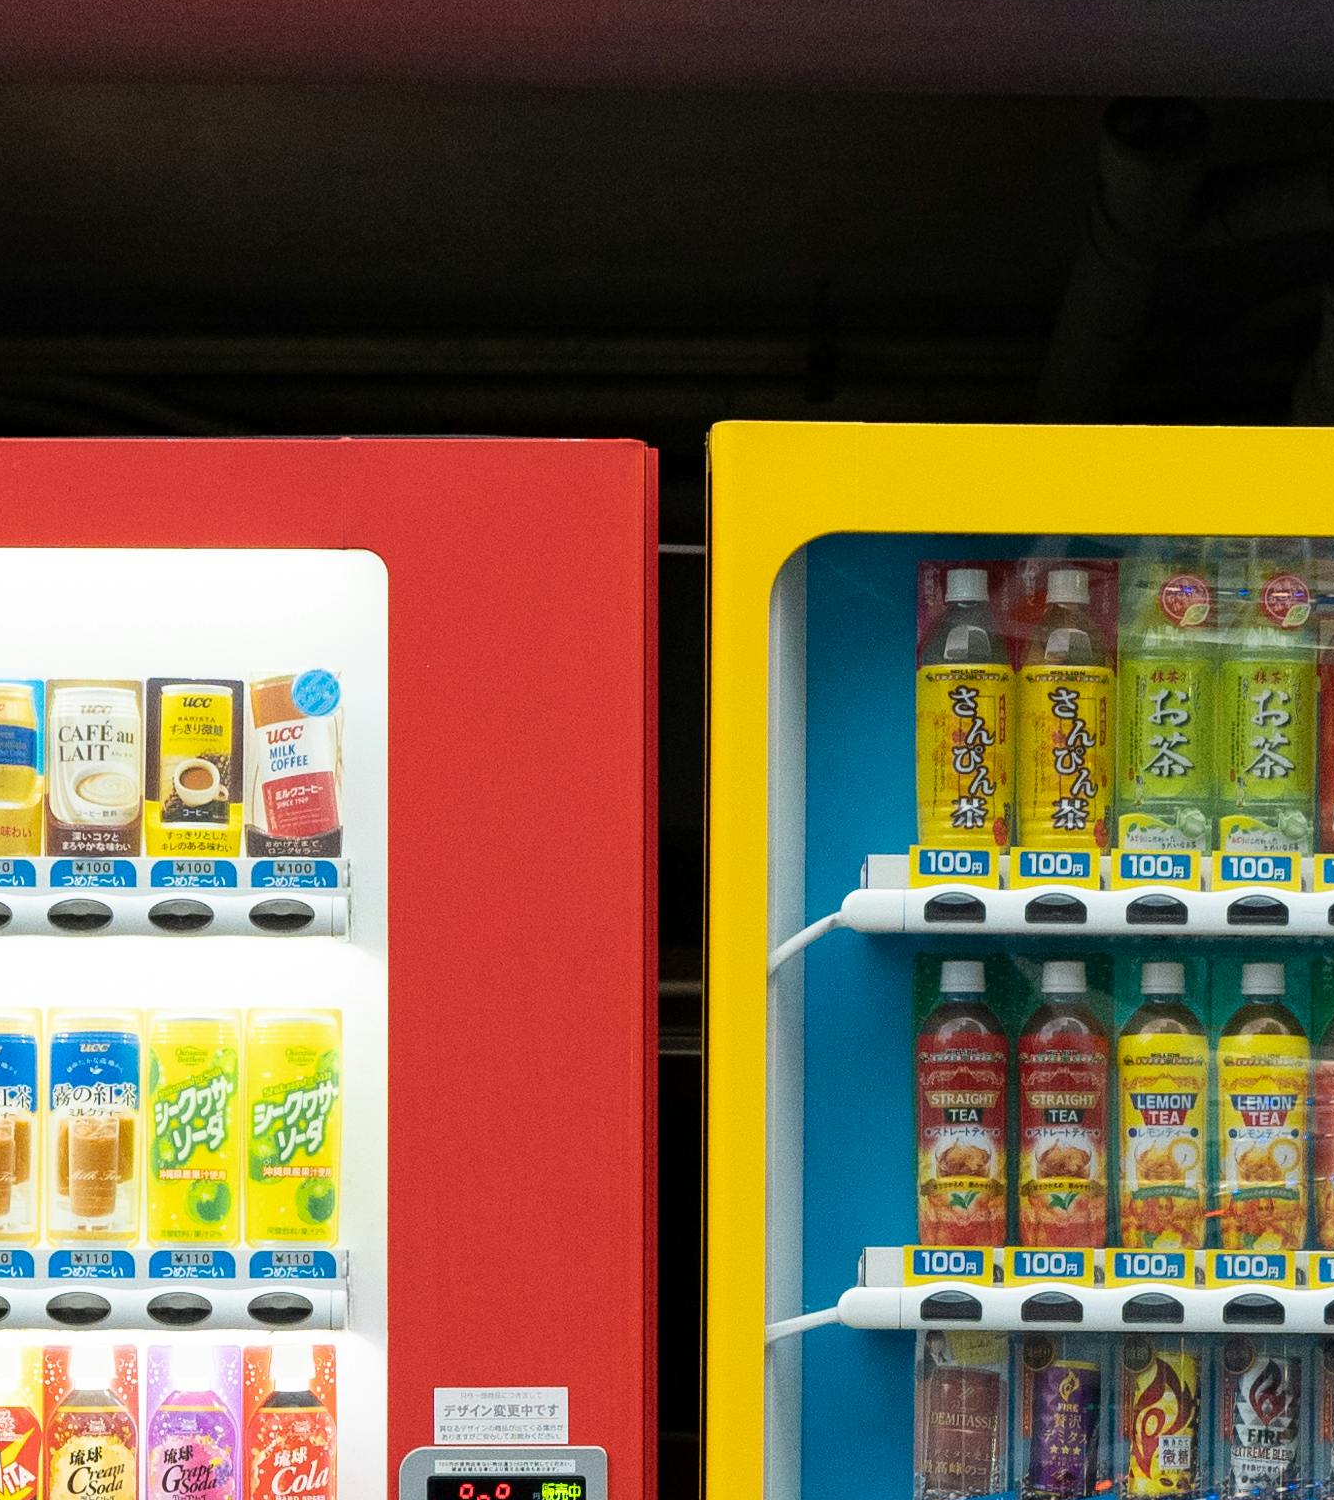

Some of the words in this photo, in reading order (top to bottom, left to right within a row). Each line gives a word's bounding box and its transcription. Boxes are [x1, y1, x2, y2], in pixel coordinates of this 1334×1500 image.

[59, 722, 113, 744] CAFÉ
[116, 731, 134, 744] au
[1144, 689, 1195, 780] お茶
[1245, 689, 1295, 780] お茶
[59, 745, 109, 762] LAIT
[269, 744, 296, 759] MILK
[949, 686, 996, 829] さんぴん茶
[1049, 687, 1097, 831] さんぴん茶
[271, 754, 309, 772] COFFEE
[275, 783, 324, 800] ミルクコーヒー
[61, 841, 132, 852] まろやかな味わい
[71, 832, 120, 843] 深いコクと
[276, 862, 312, 873] ¥100
[928, 851, 983, 874] 100円
[1129, 855, 1184, 878] 100円
[931, 1093, 994, 1106] STRAIGHT
[1031, 1094, 1095, 1106] STRAIGHT
[1137, 1095, 1192, 1110] LEMON
[1237, 1096, 1292, 1111] LEMON
[948, 1110, 979, 1122] TEA
[1049, 1110, 1079, 1123] TEA
[173, 1122, 226, 1161] ソーダ
[1138, 1127, 1191, 1138] レモンティー
[921, 1251, 977, 1274] 100円
[1123, 1254, 1179, 1278] 100円
[443, 1404, 560, 1418] デザイン変更中です
[70, 1447, 103, 1465] 琉球
[164, 1446, 193, 1464] 琉球
[1162, 1448, 1189, 1467] 微糖
[67, 1463, 125, 1494] Cream
[162, 1462, 214, 1493] Grape
[270, 1462, 329, 1495] Cola
[88, 1478, 123, 1497] Soda
[180, 1478, 218, 1496] Soda
